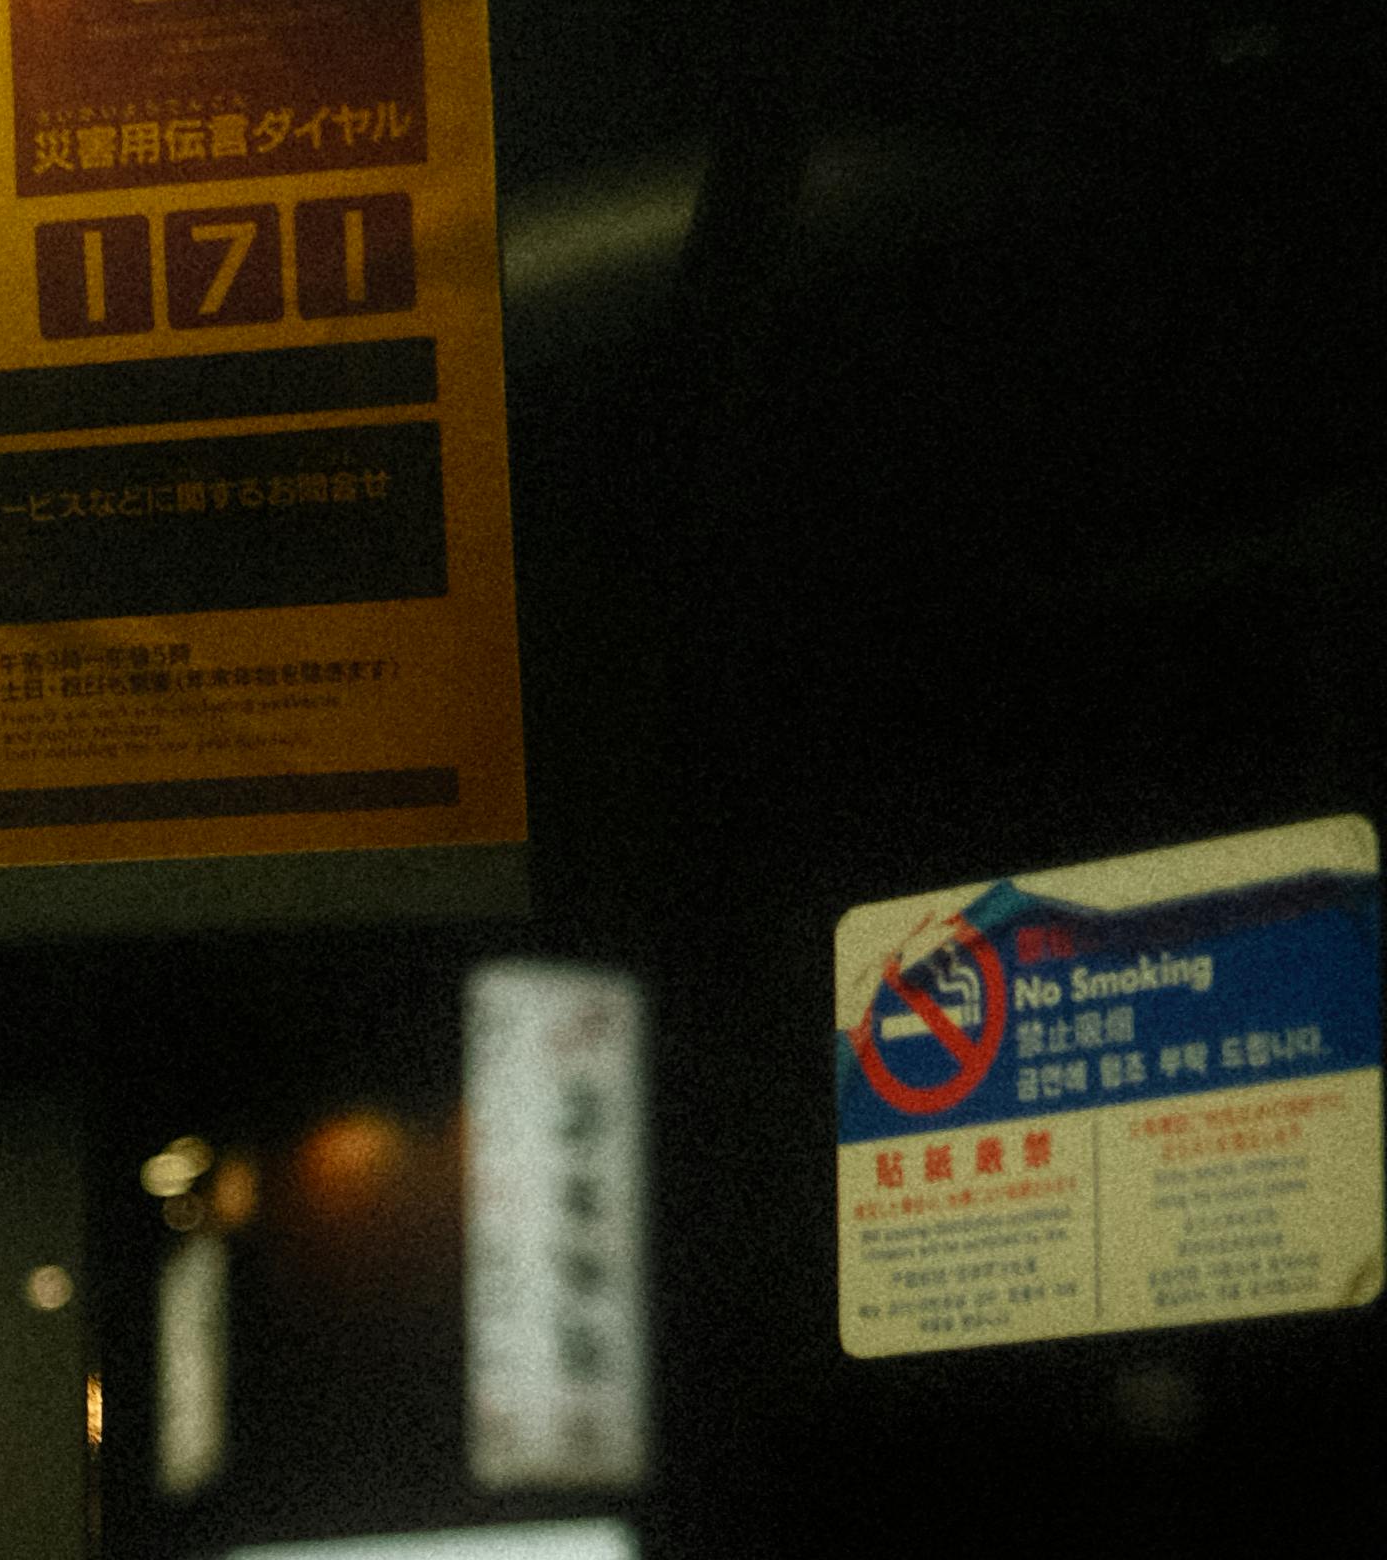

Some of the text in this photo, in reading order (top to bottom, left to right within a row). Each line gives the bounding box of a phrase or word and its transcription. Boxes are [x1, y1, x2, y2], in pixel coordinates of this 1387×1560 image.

[32, 100, 411, 176] 災害用伝言ダイヤル
[82, 209, 368, 324] 171
[1013, 951, 1214, 1011] No Smoking
